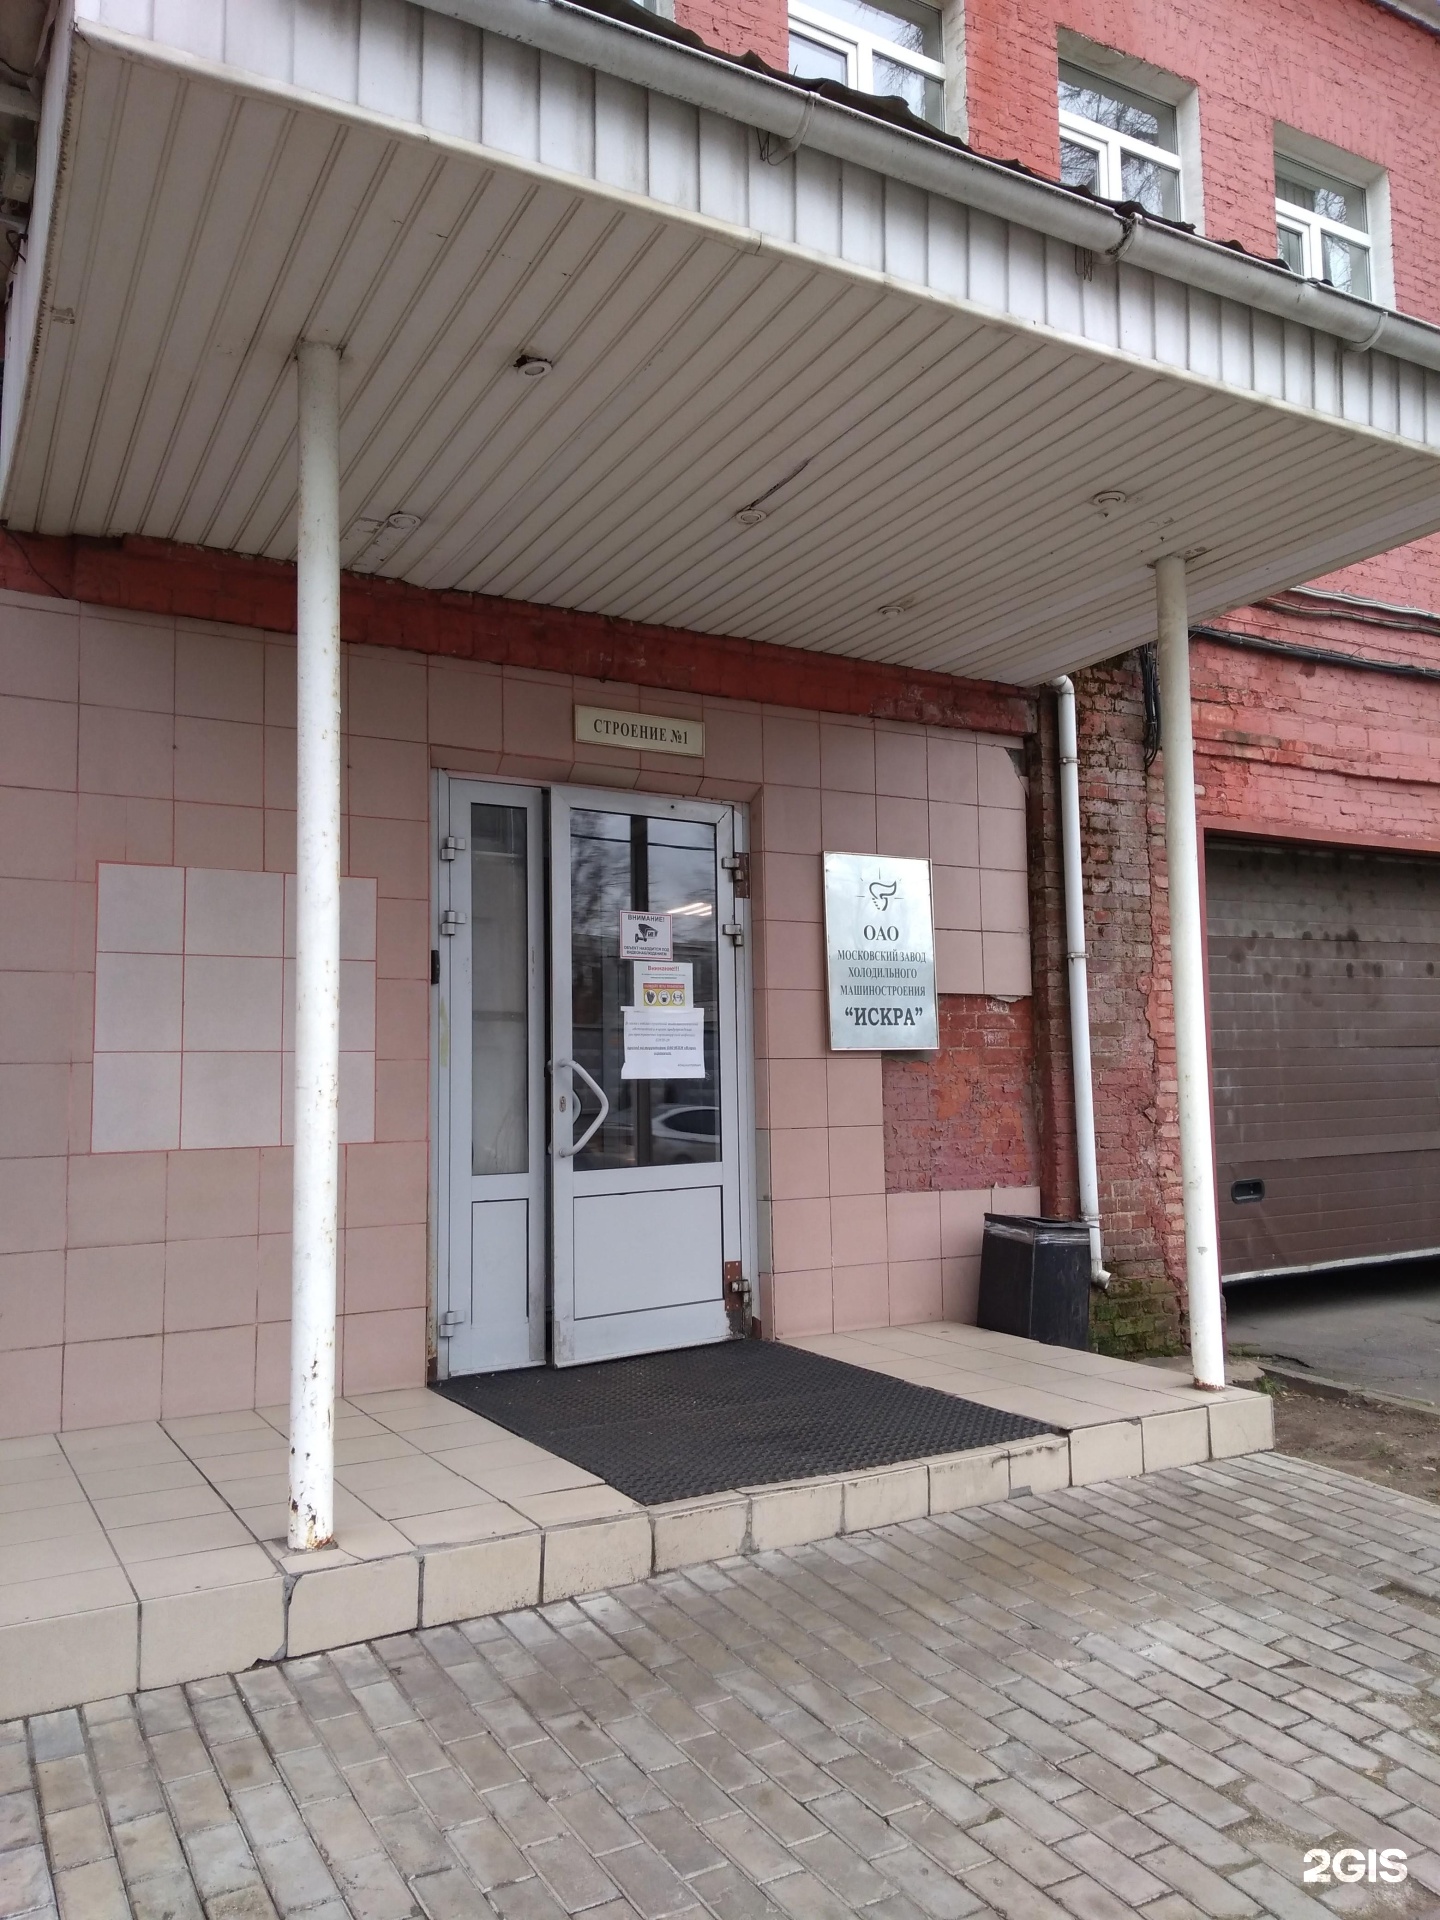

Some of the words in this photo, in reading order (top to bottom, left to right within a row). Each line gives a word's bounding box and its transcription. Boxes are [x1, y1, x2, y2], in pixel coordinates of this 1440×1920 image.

[594, 719, 667, 742] СТРОЕНИЕ
[670, 729, 689, 745] №1
[627, 914, 665, 922] ВНИМАНИЕ!
[863, 925, 899, 941] ОАО
[837, 949, 899, 962] МОСКОВСКИЙ
[900, 951, 927, 963] ЗАВОД
[848, 967, 918, 980] ХОЛОДИЛЬНОГО
[840, 985, 926, 997] МАШИНОСТРОЕНИЯ
